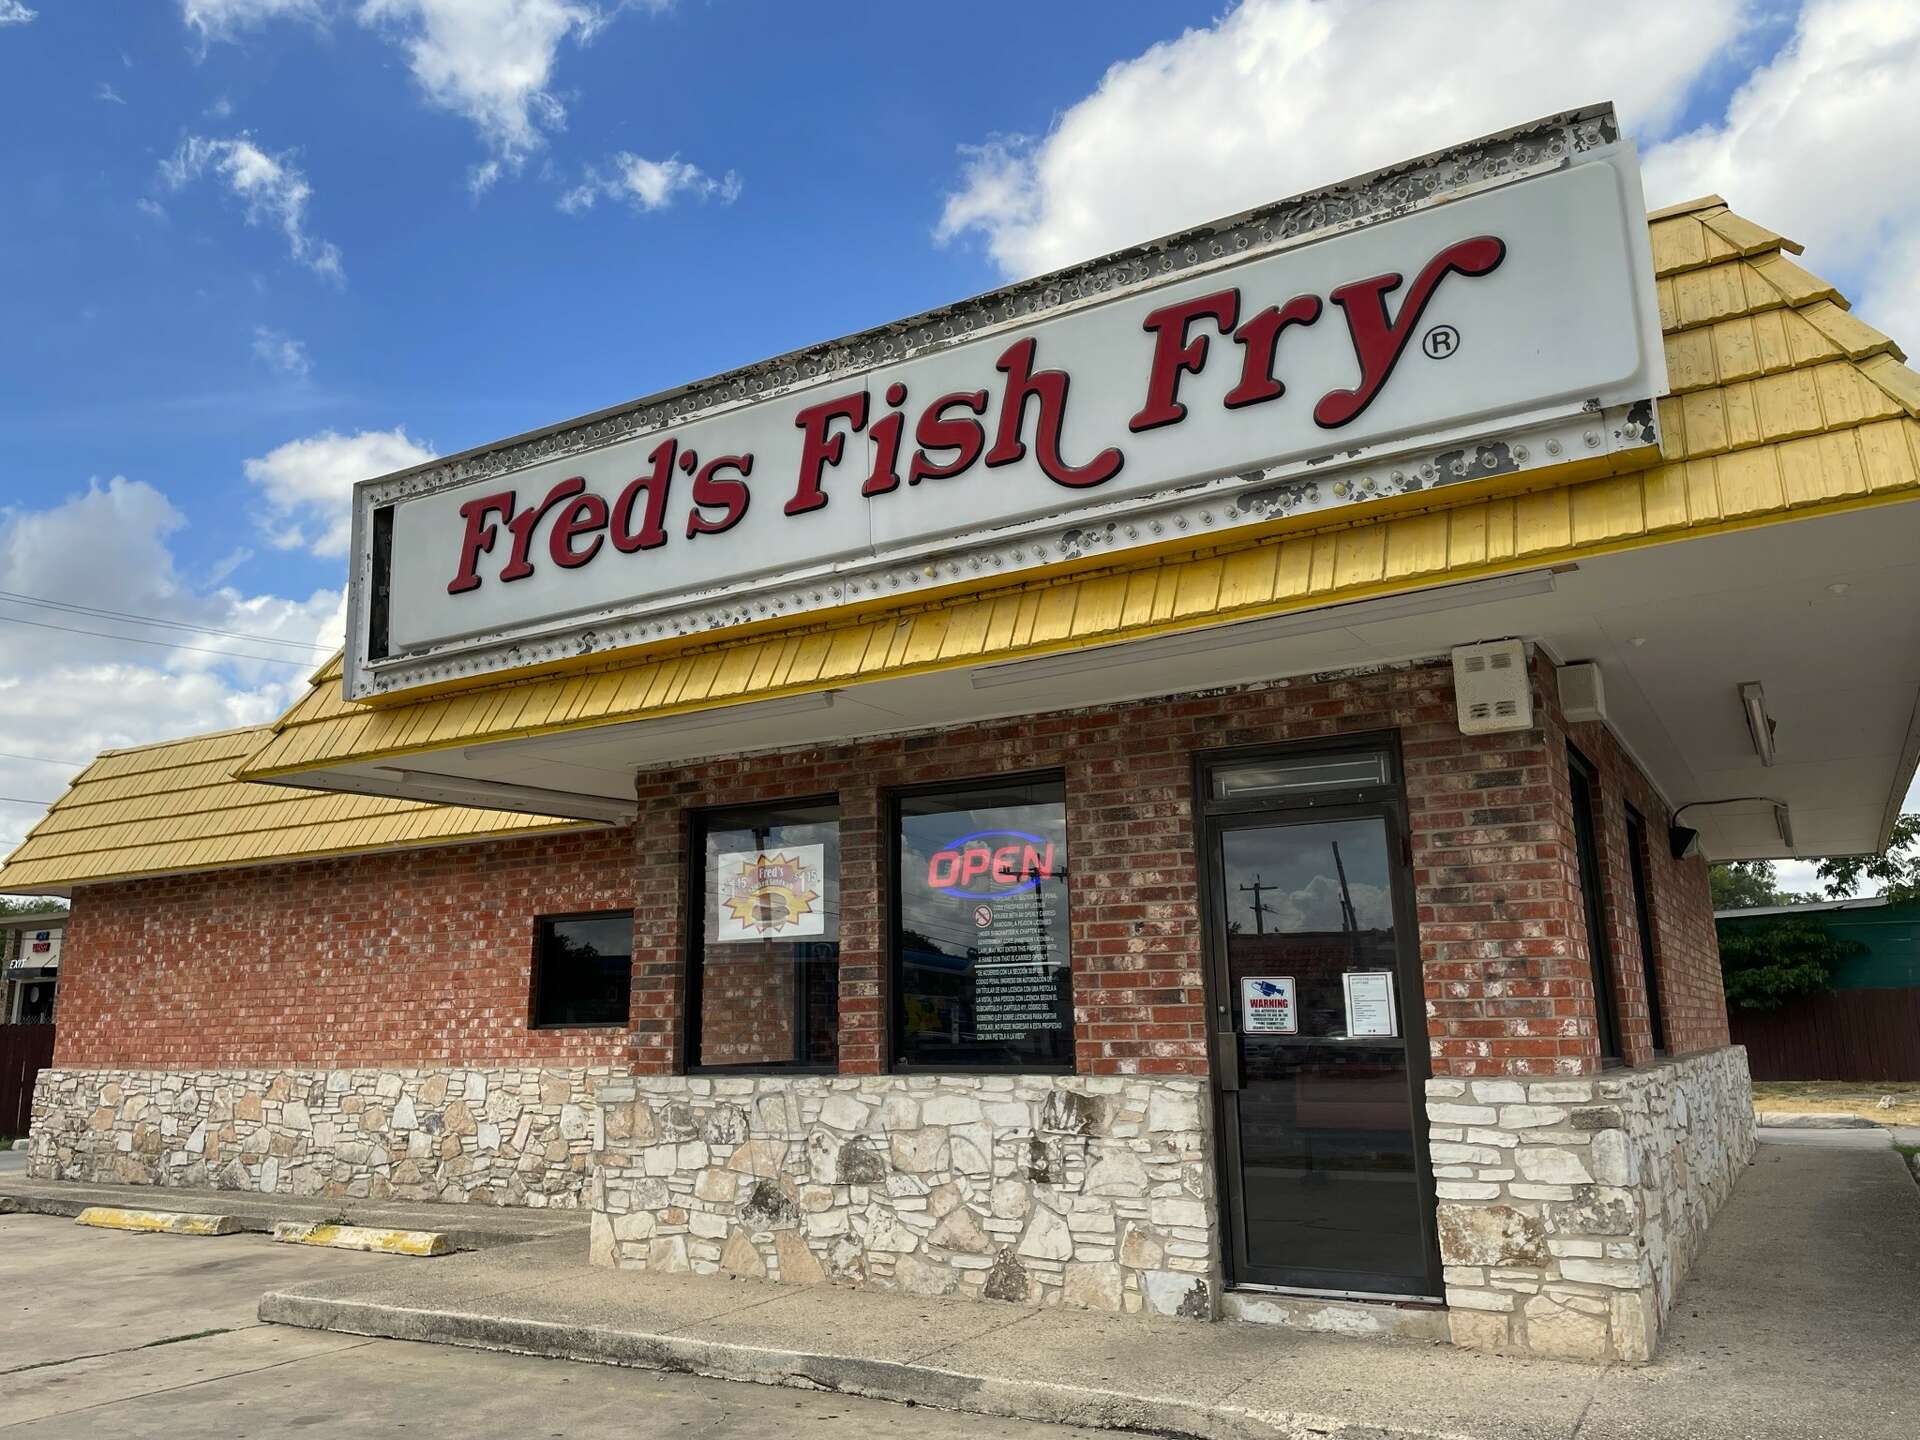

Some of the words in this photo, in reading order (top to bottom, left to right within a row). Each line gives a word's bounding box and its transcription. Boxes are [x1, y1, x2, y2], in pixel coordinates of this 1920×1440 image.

[447, 437, 755, 596] Fred's
[784, 337, 1125, 517] Fish
[1129, 234, 1507, 429] Fry
[928, 840, 1055, 888] OPEN
[760, 866, 784, 878] Fred's
[10, 959, 26, 969] EXIT
[1250, 999, 1288, 1008] WARNING
